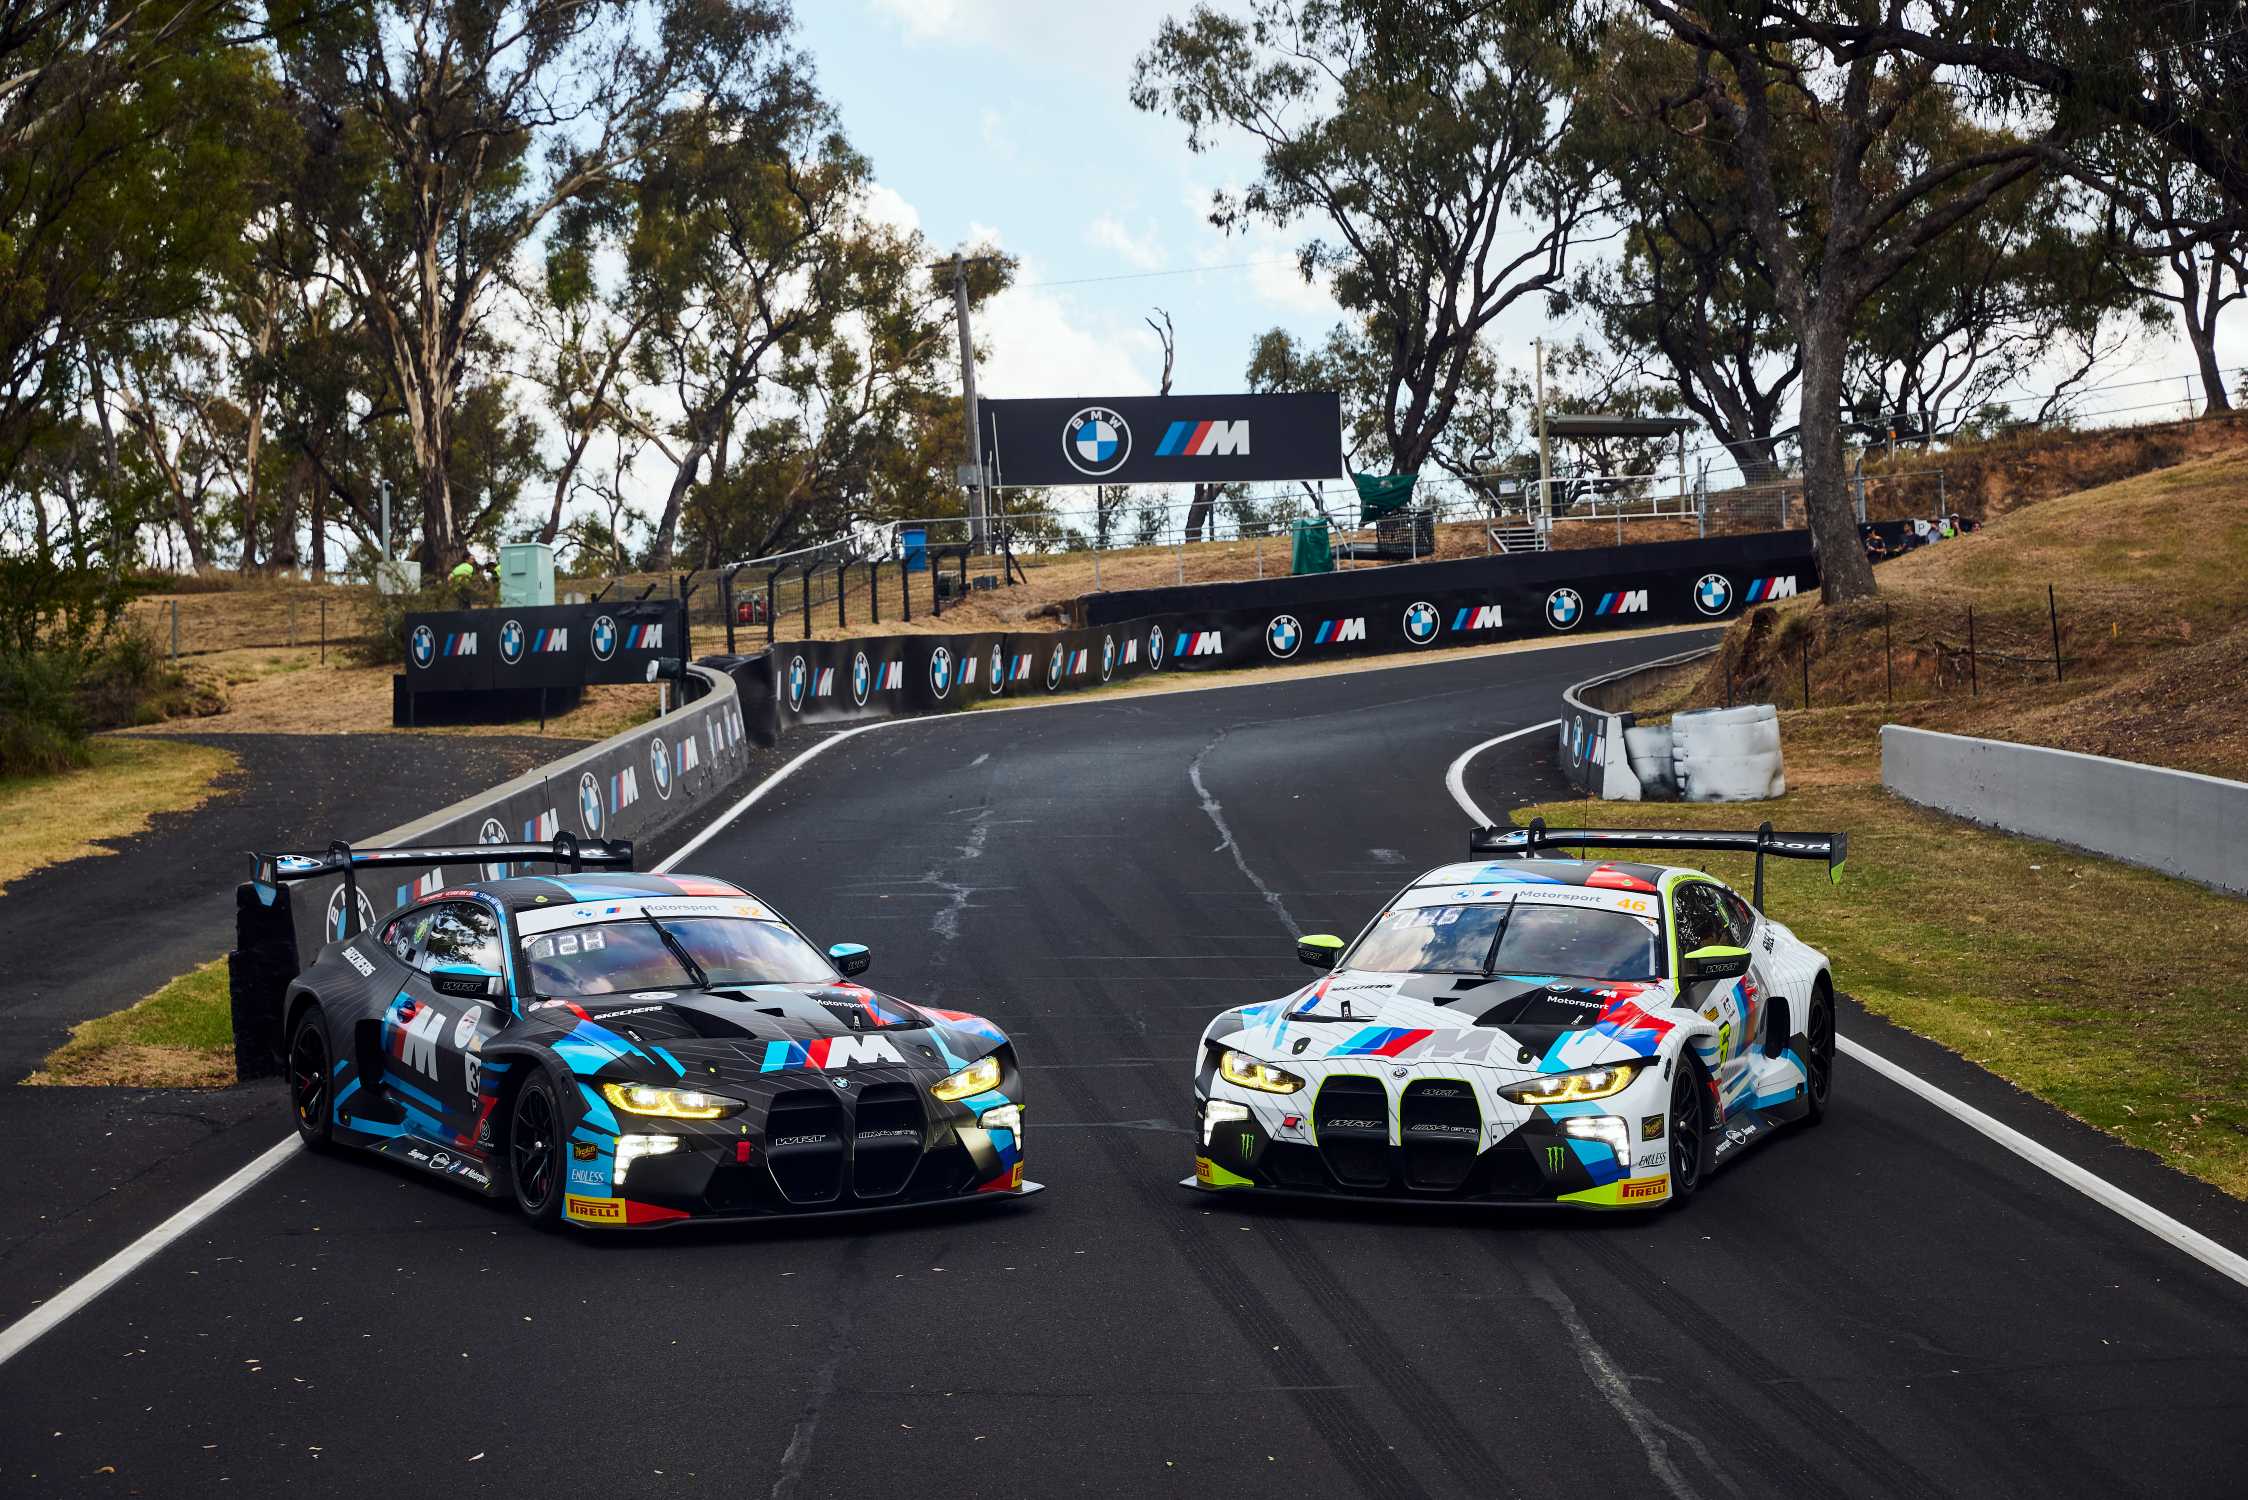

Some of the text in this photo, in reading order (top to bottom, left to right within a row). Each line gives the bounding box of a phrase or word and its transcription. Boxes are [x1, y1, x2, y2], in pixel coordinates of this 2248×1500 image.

[1071, 410, 1122, 431] BMW
[1195, 420, 1250, 456] M
[1618, 590, 1648, 614] M
[1473, 605, 1503, 629] M
[1336, 617, 1366, 642] M
[1519, 889, 1648, 912] Motorsport 46
[593, 1005, 663, 1020] SKECHERS
[1546, 995, 1609, 1010] Motorsport
[1622, 1180, 1666, 1198] PIRELLI
[569, 1198, 620, 1217] PIRELLI
